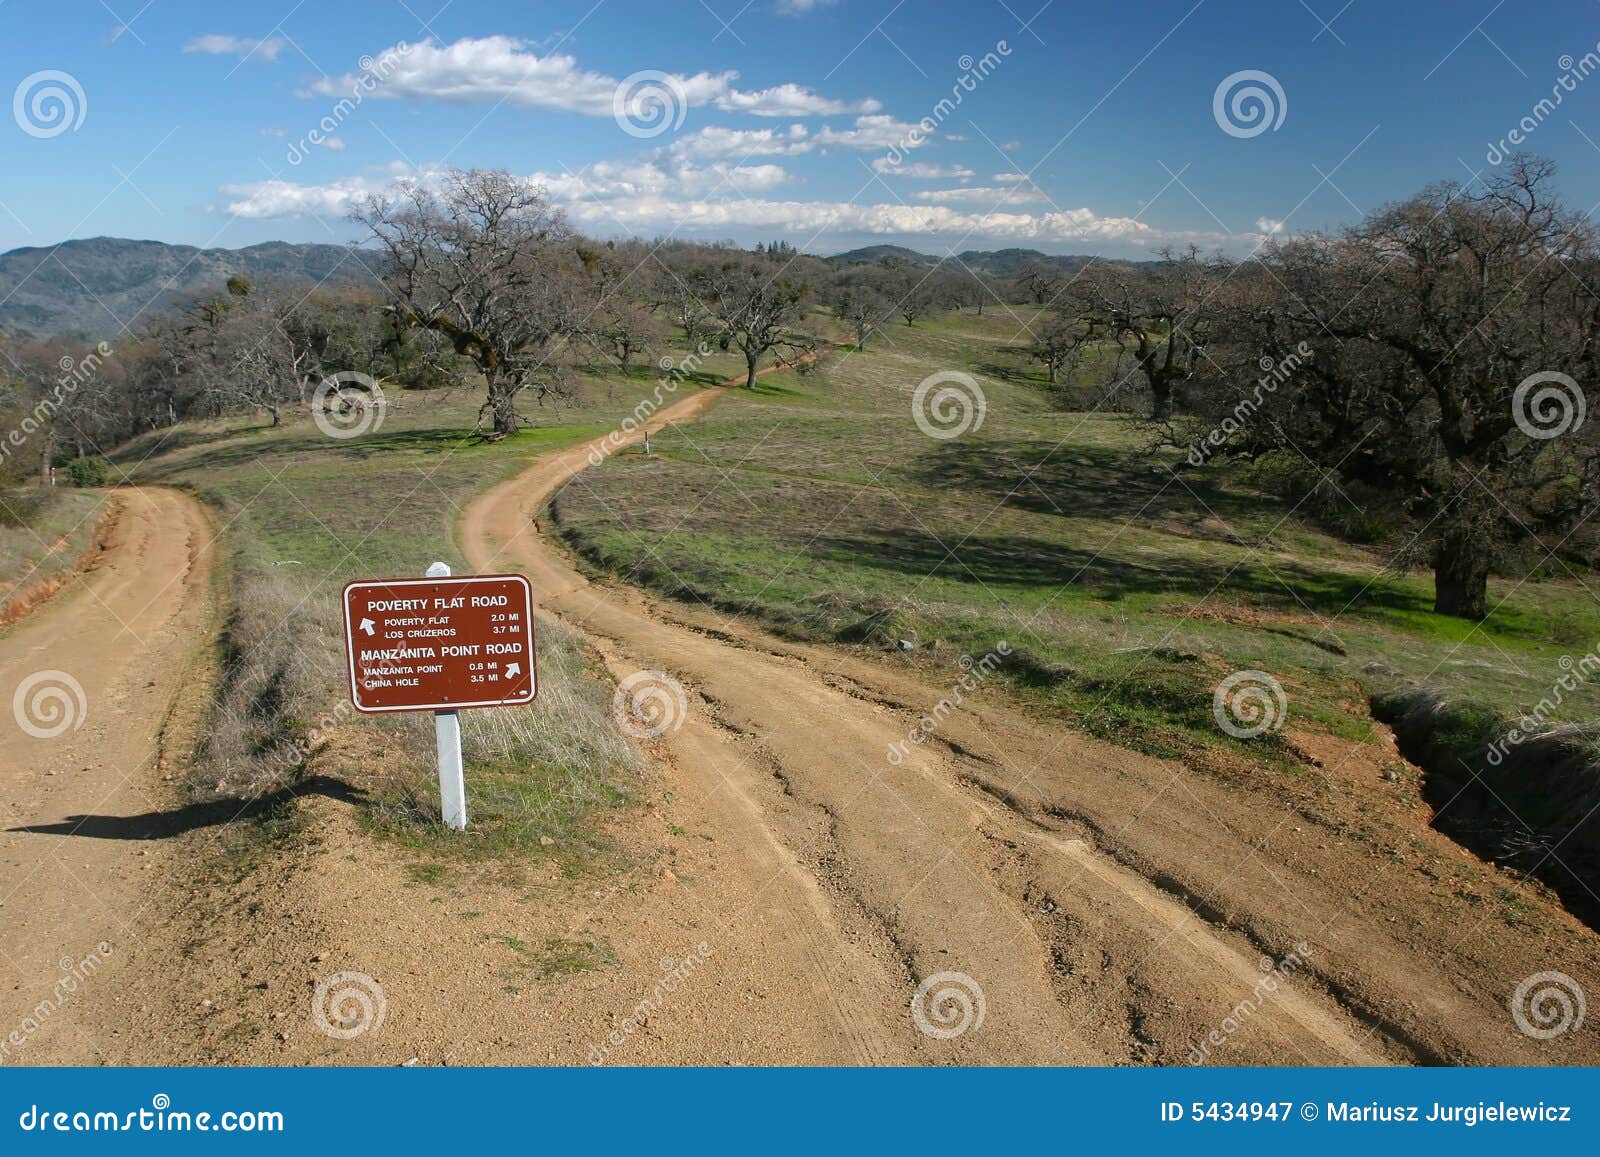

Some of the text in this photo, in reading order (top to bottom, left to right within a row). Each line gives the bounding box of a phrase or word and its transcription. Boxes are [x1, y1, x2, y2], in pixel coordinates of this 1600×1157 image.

[367, 595, 508, 612] POVERTY FLAT ROAD
[384, 616, 450, 627] POVERTY FLAT
[491, 613, 519, 622] 2.0 MI
[384, 628, 457, 639] LOS CRUZEROS
[492, 625, 520, 634] 3.7 MI
[361, 642, 522, 661] MANZANITA POINT ROAD
[363, 664, 443, 676] MANZANITA POINT
[469, 662, 498, 671] 0.8 MI
[365, 678, 420, 688] CHINA HOLE
[470, 674, 499, 683] 3.5 MI
